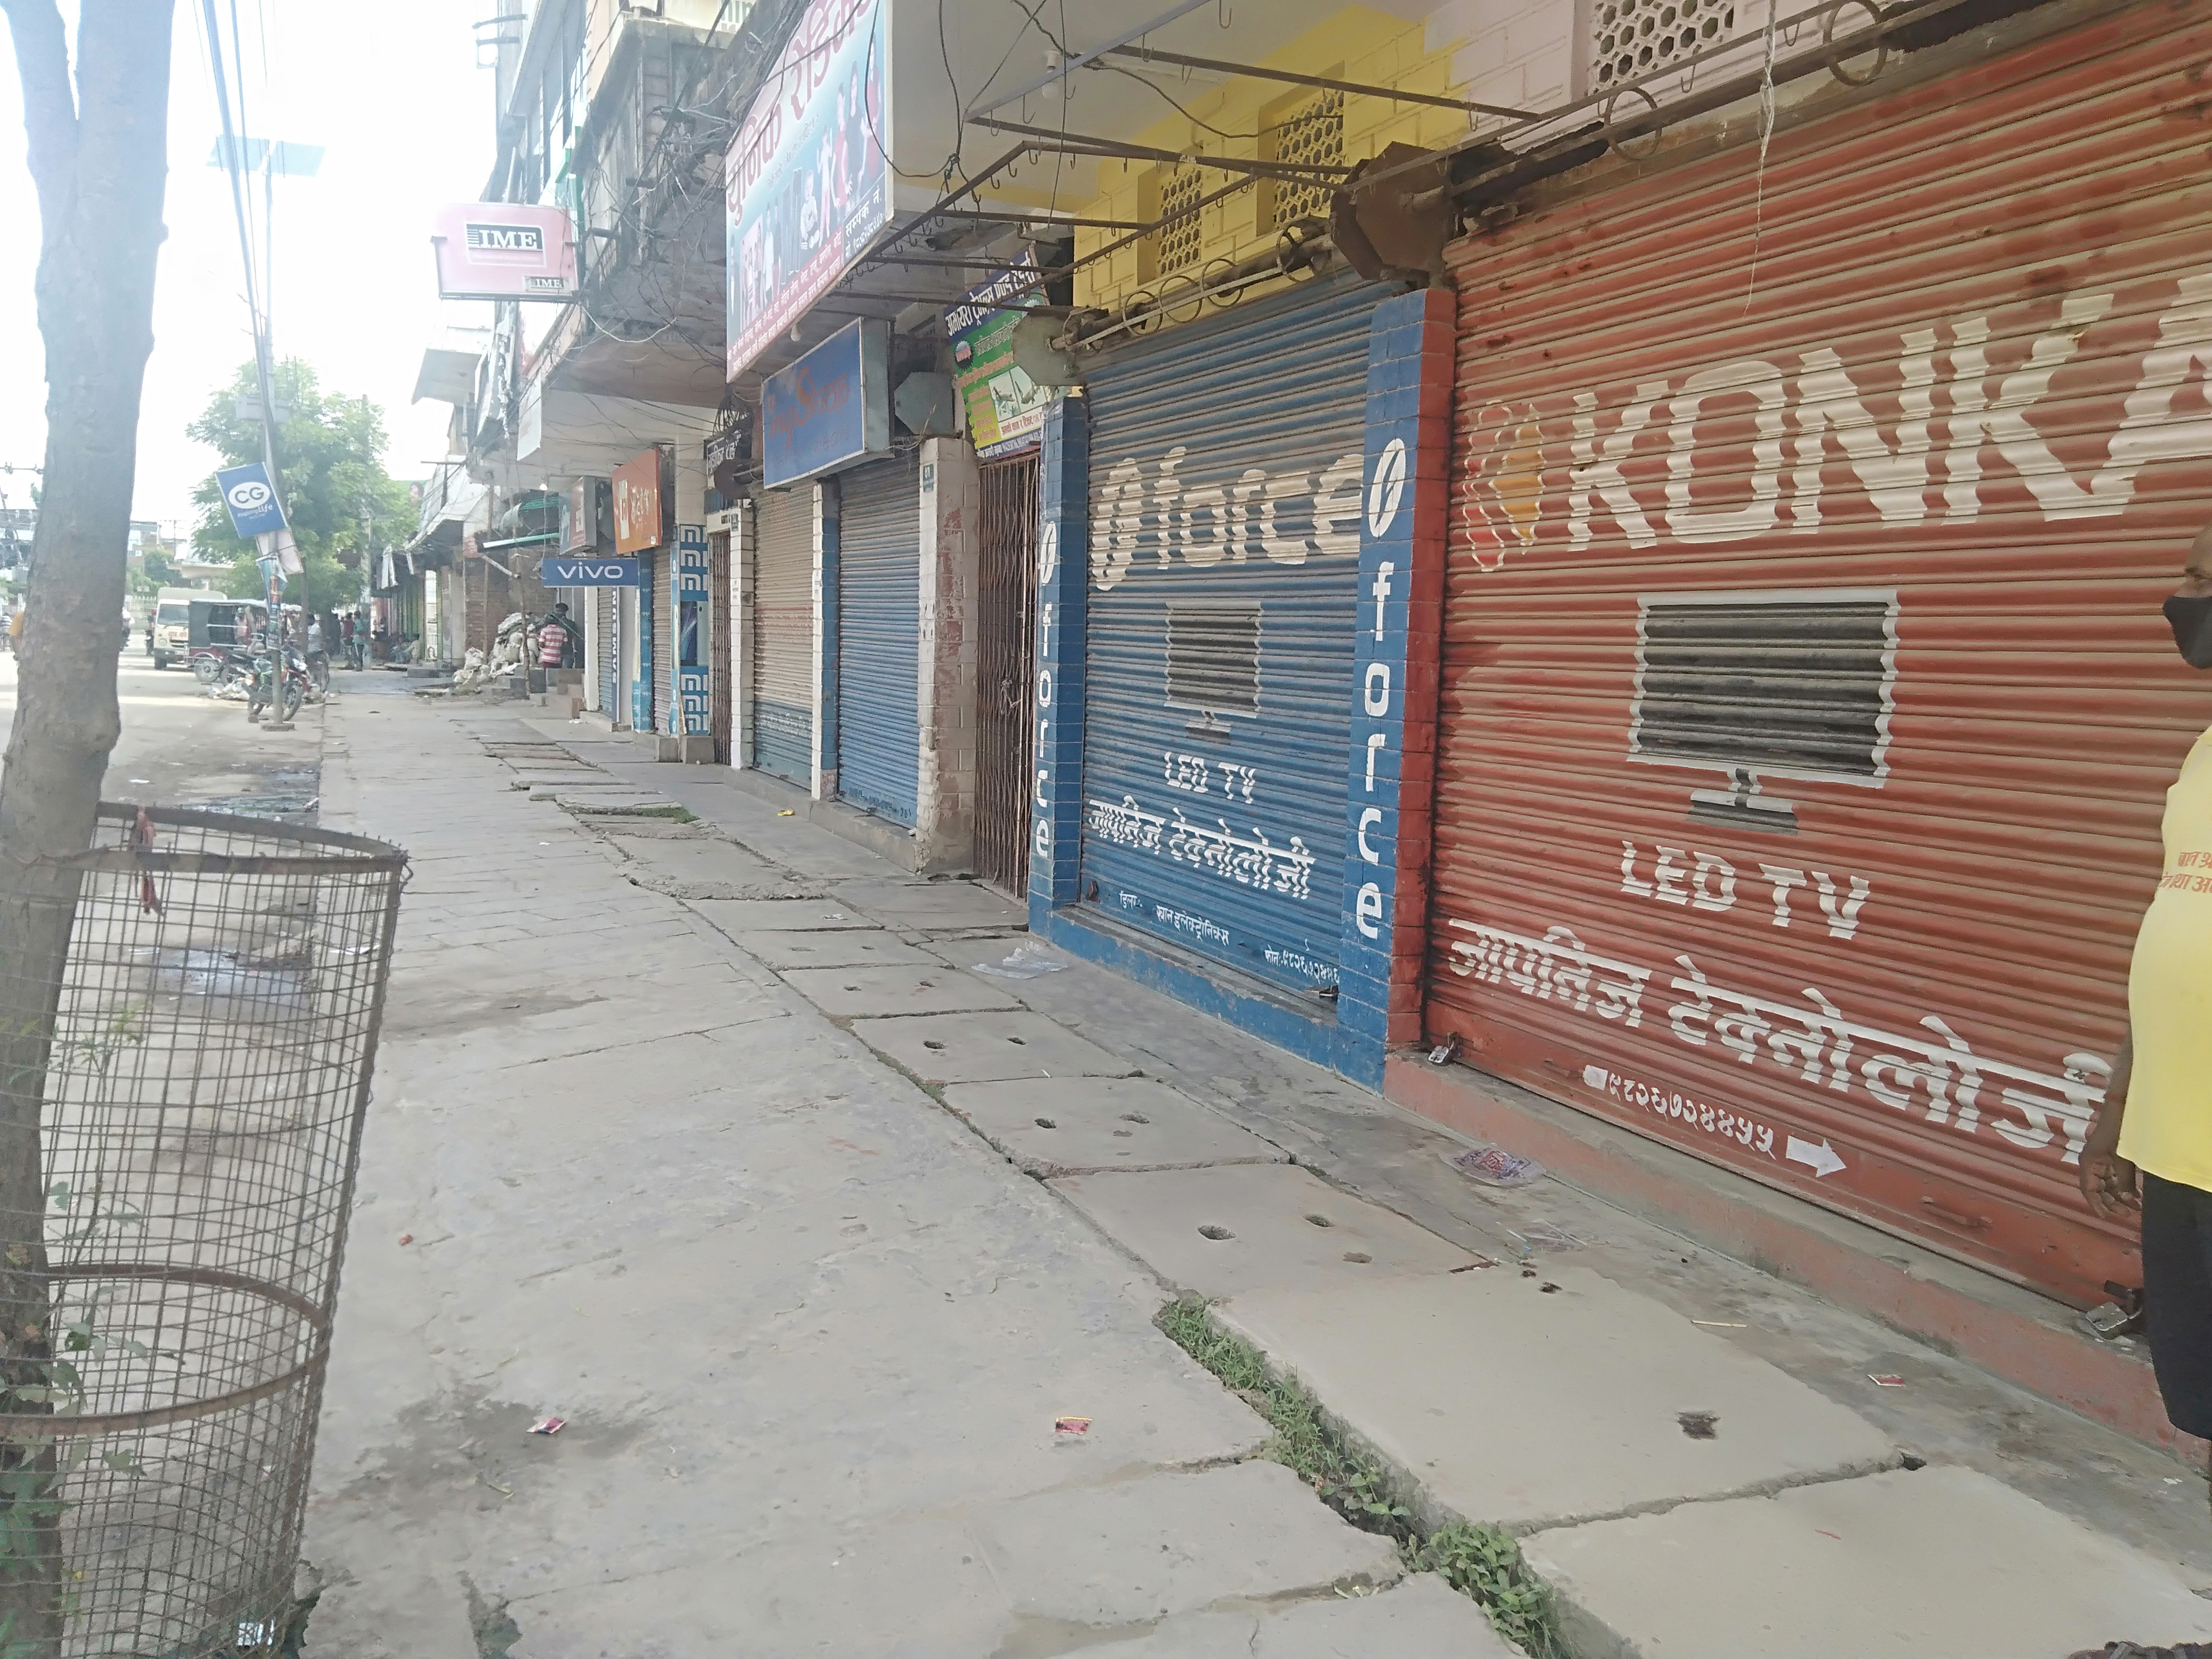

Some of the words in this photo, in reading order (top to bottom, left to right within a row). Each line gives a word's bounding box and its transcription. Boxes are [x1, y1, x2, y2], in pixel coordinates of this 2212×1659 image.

[479, 229, 537, 249] IME
[845, 200, 869, 237] सम्पर्क
[535, 279, 562, 289] IME
[797, 366, 849, 426] Shop
[1568, 272, 2212, 551] KONIKA
[235, 487, 264, 504] CG
[1153, 446, 1364, 570] force
[557, 562, 624, 579] vivo
[1035, 603, 1052, 858] force
[1356, 561, 1392, 940] force
[1164, 752, 1209, 793] LED
[1218, 761, 1256, 804] TV
[1620, 841, 1737, 912] LED
[1759, 864, 1870, 940] TV
